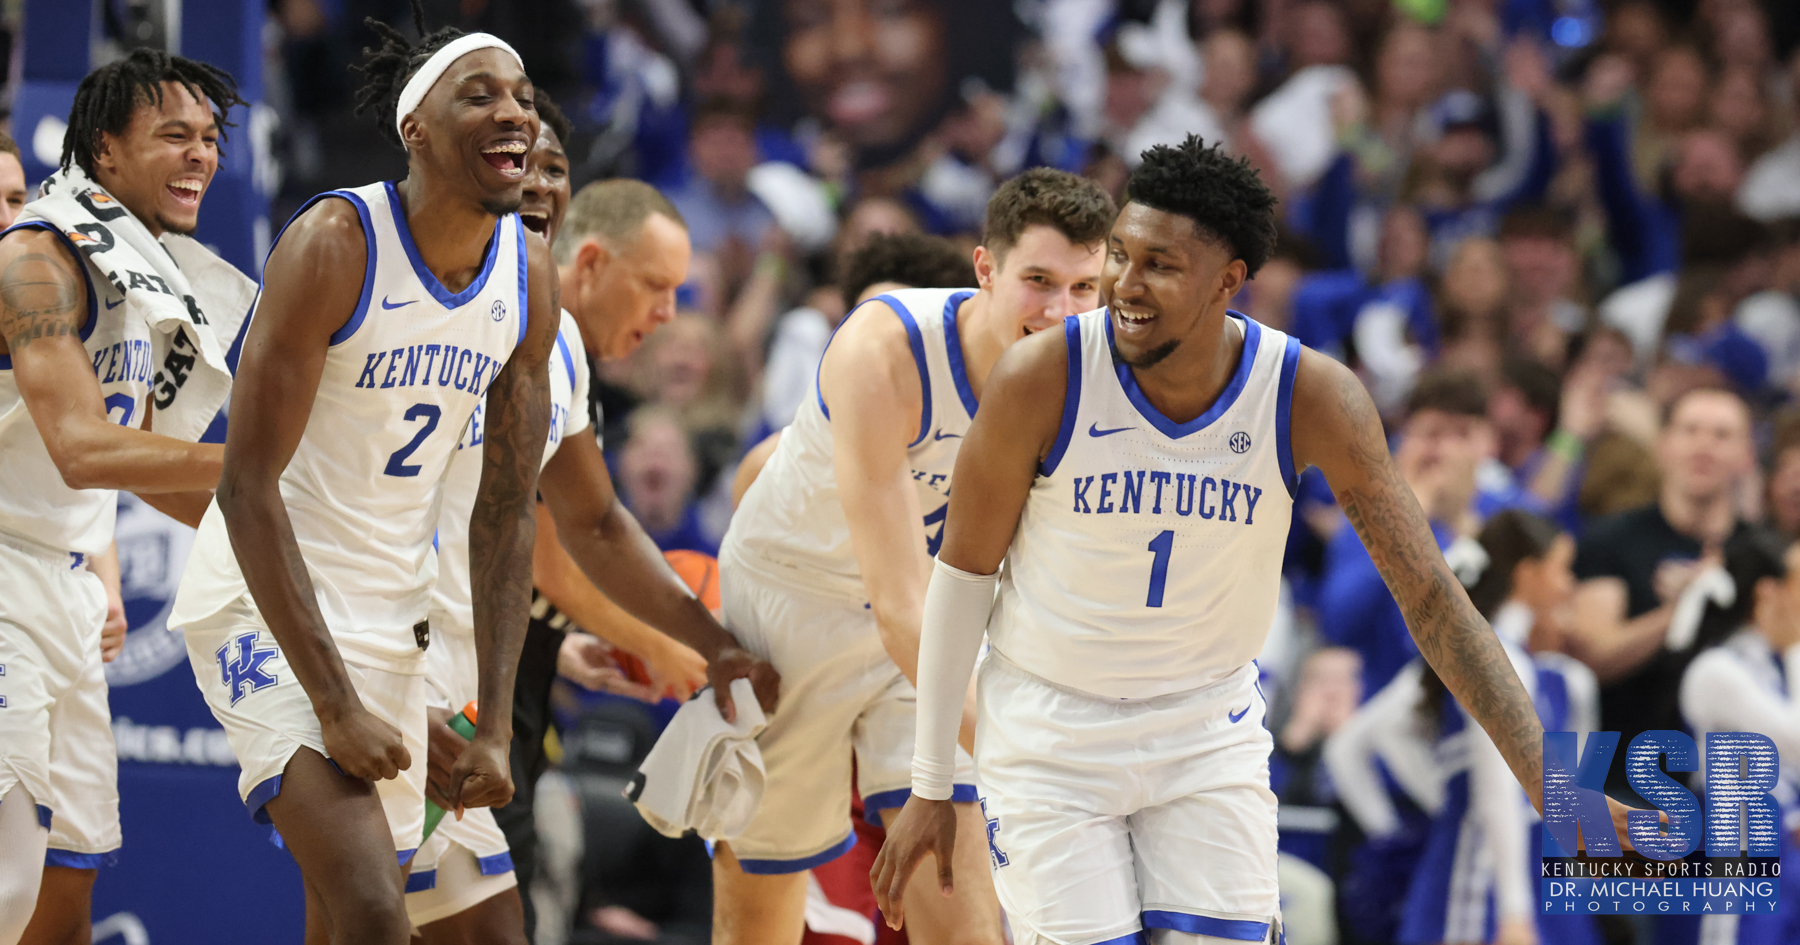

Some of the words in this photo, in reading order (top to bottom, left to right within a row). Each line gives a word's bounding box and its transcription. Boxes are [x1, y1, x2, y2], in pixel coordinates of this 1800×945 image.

[492, 300, 506, 321] SEC
[355, 344, 502, 398] KENTUCKY
[383, 403, 442, 477] 2
[1229, 432, 1252, 454] SEC
[1073, 470, 1262, 525] KENTUCKY
[1146, 530, 1174, 608] 1
[216, 631, 279, 709] UK
